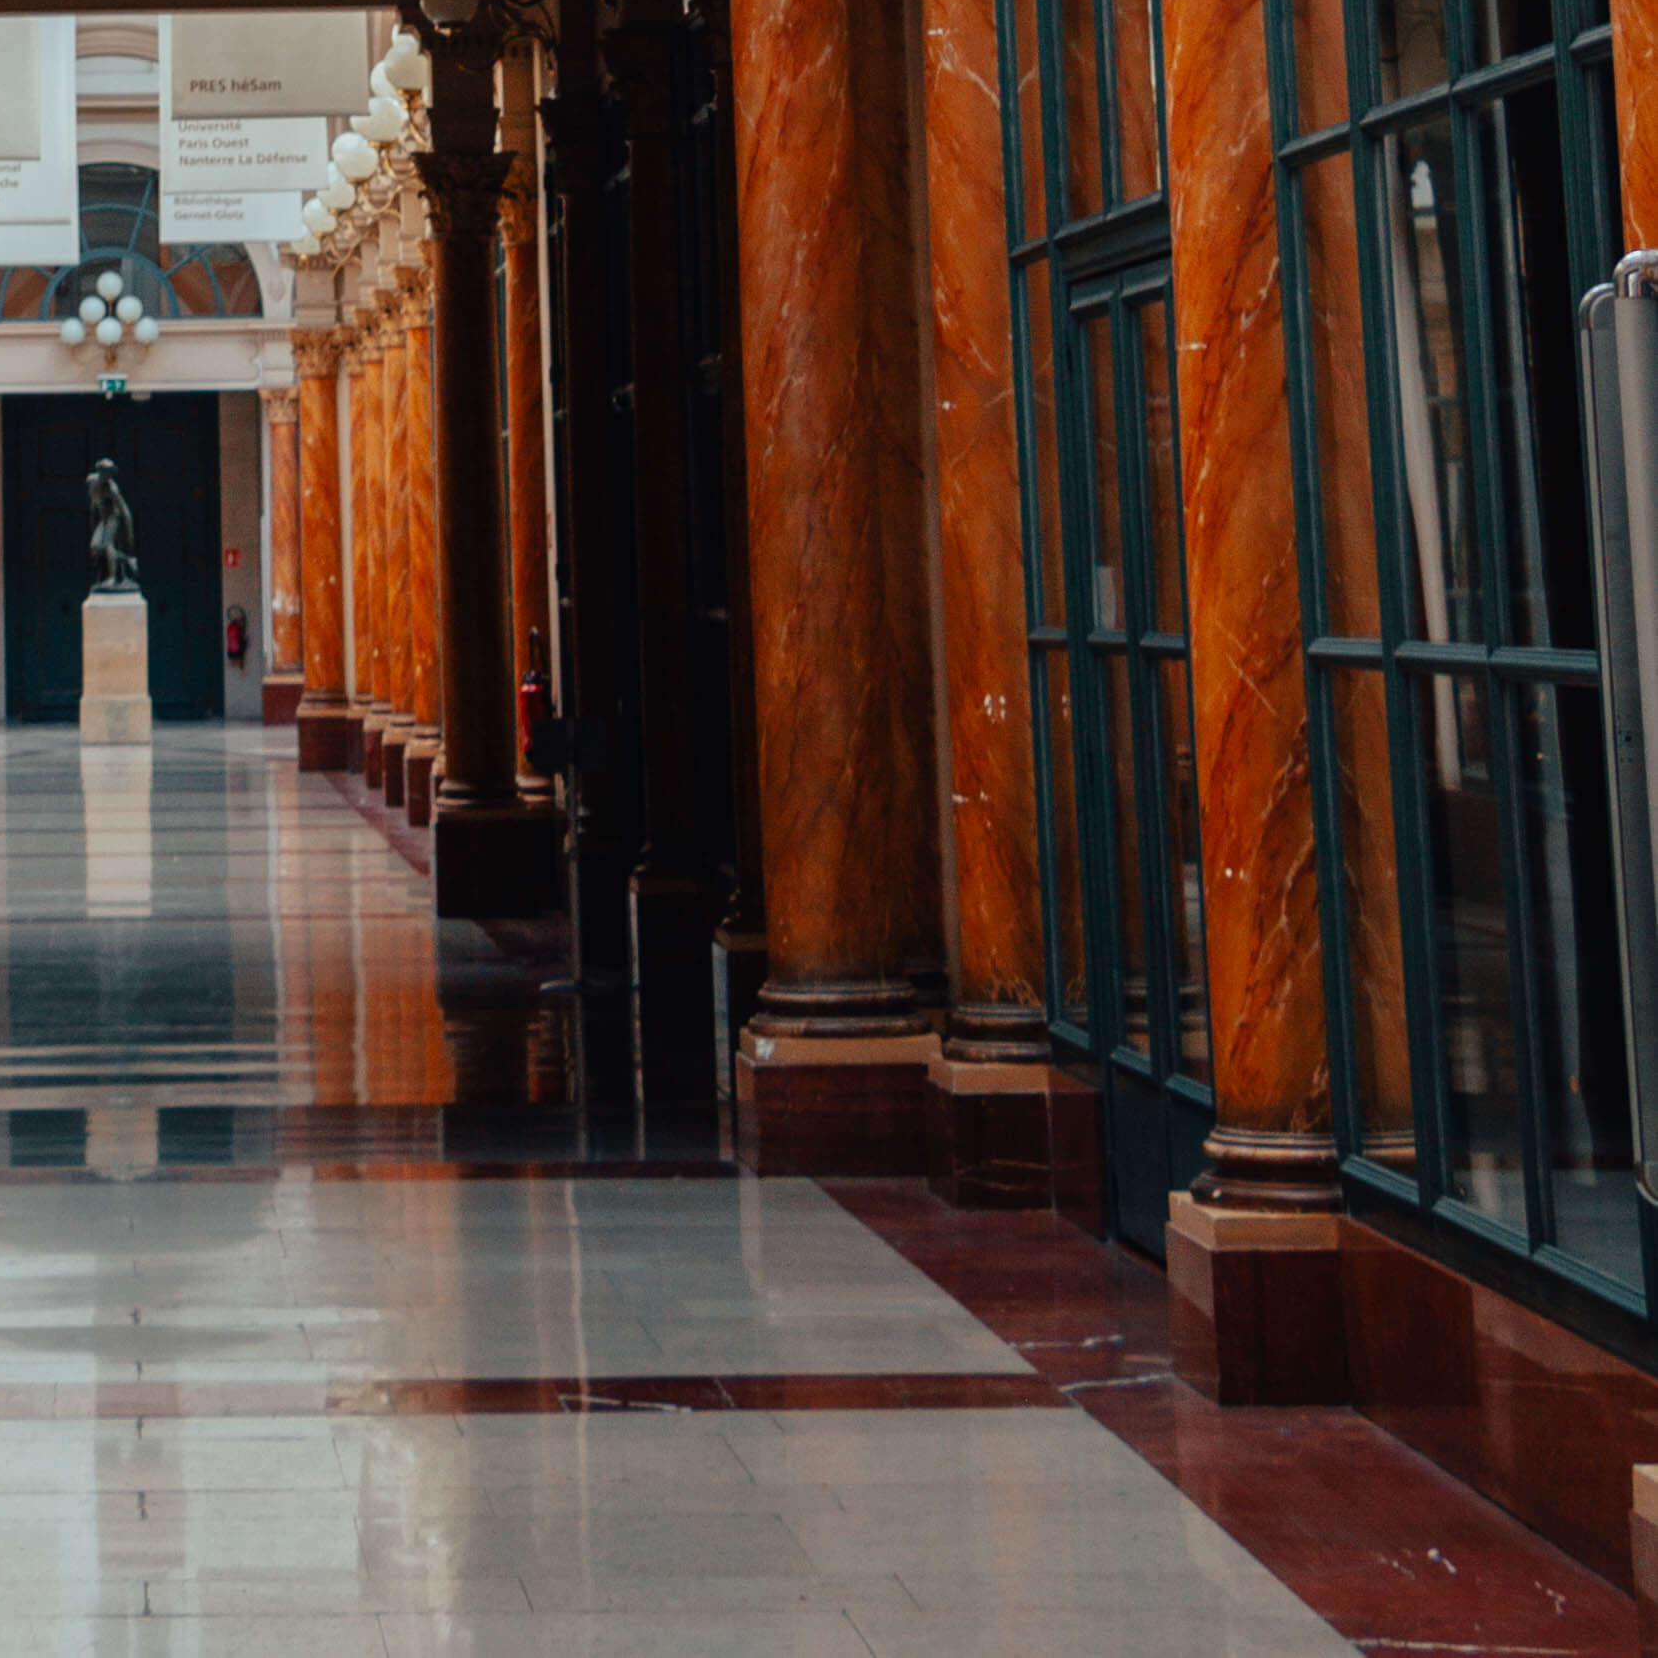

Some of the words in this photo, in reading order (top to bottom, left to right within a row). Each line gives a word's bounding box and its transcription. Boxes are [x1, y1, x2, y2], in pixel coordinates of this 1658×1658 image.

[190, 79, 226, 92] PRES
[178, 121, 242, 132] Université
[178, 139, 209, 149] Paris
[212, 138, 250, 149] Ouest
[179, 156, 235, 165] Nanterre
[238, 155, 253, 165] La
[256, 153, 308, 165] Défense
